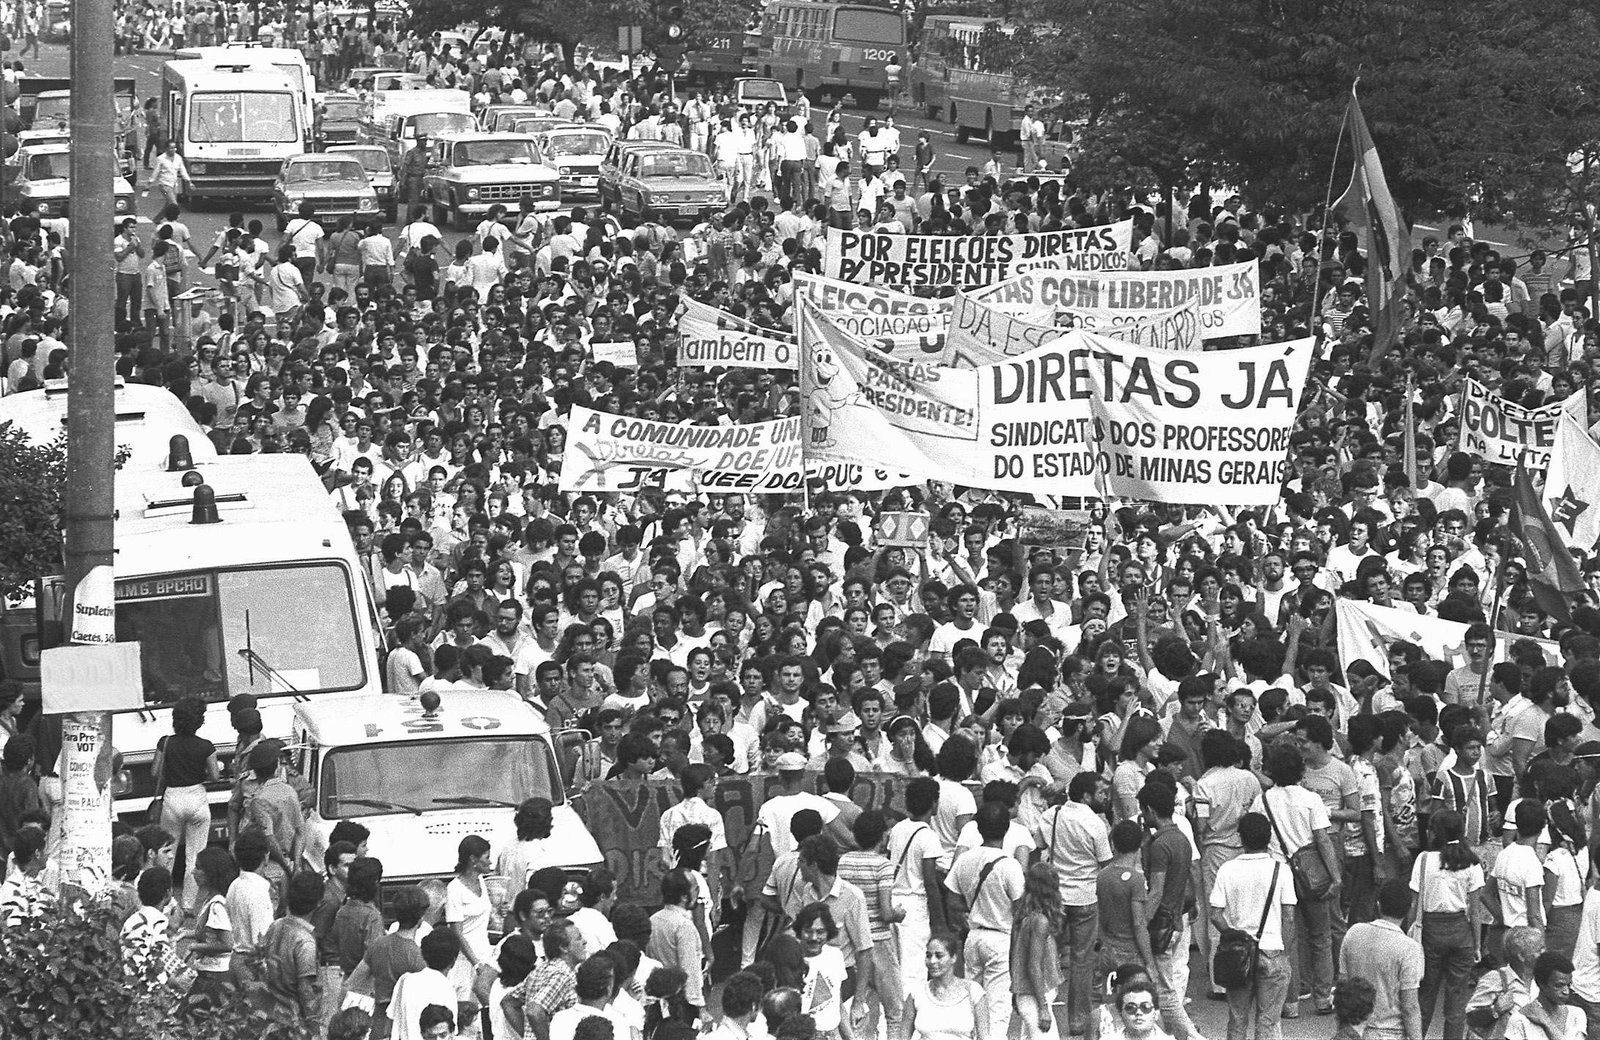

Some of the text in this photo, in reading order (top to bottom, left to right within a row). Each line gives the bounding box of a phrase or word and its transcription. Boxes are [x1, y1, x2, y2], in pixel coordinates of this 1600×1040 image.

[864, 48, 896, 62] 1202
[840, 232, 893, 262] POR
[1021, 228, 1118, 259] DIRETAS
[1041, 276, 1100, 309] COM
[1107, 275, 1223, 309] LIBERDADE
[1226, 265, 1255, 300] JÁ
[681, 335, 790, 363] Também o
[992, 346, 1295, 410] DIRETAS JÁ
[1471, 382, 1562, 420] DIRETAS
[582, 413, 601, 435] A
[610, 418, 764, 449] COMUNIDADE
[990, 416, 1106, 448] SINDICATO
[1110, 419, 1157, 450] DOS
[1467, 433, 1486, 454] NA
[994, 451, 1285, 486] DO ESTADO DE MINAS GERAIS
